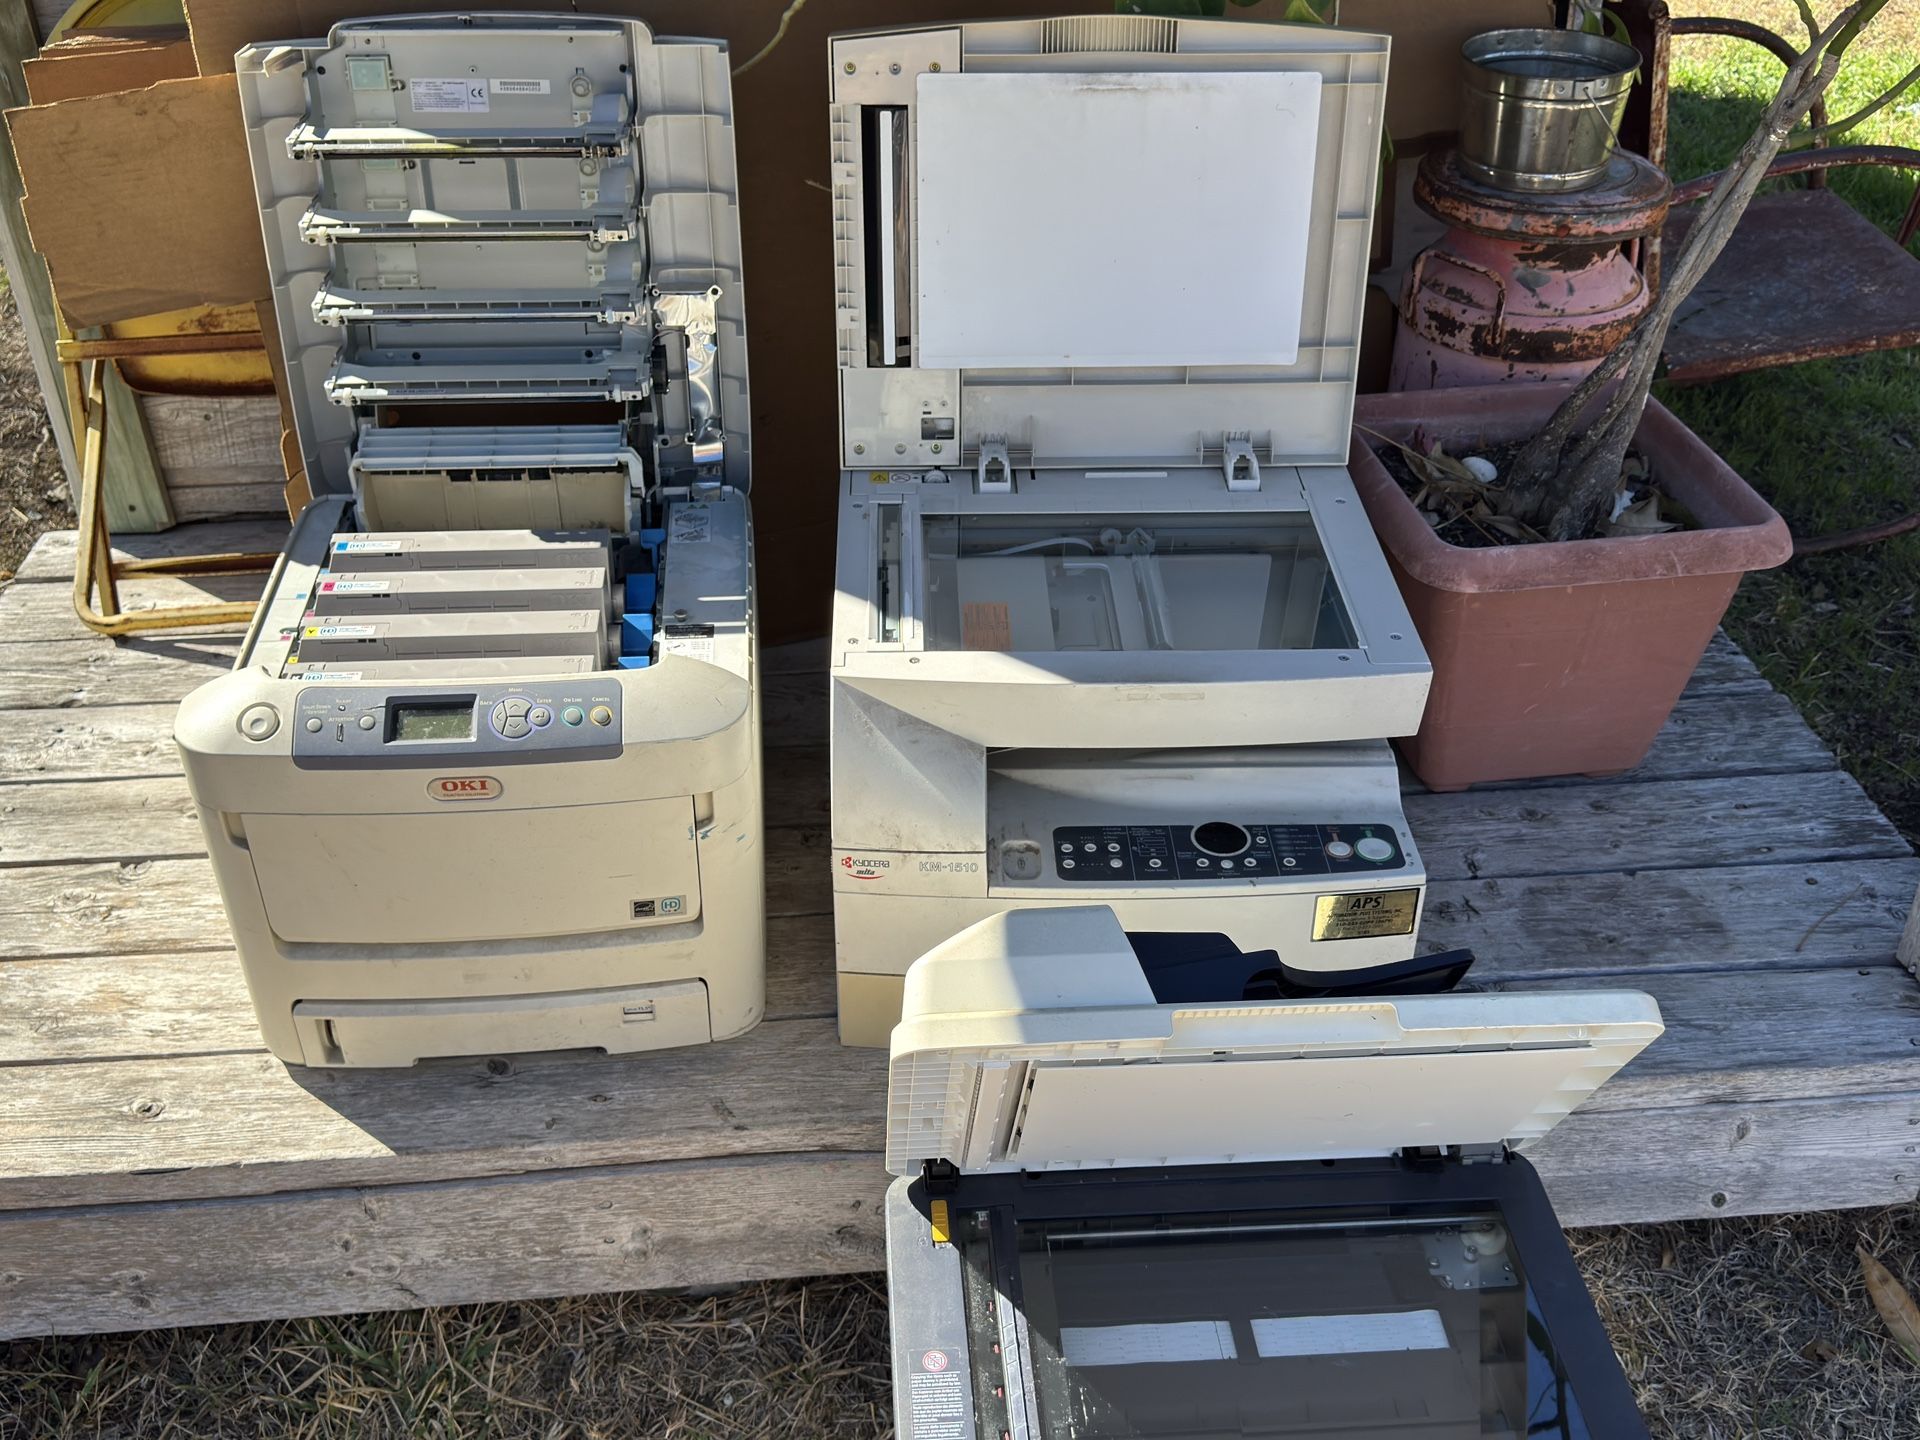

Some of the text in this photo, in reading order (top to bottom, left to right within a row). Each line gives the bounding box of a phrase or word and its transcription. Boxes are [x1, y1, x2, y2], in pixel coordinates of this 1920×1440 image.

[441, 780, 489, 792] OKI
[852, 859, 890, 868] KYOCERA
[919, 861, 979, 873] KM-1510
[1350, 896, 1382, 910] APS
